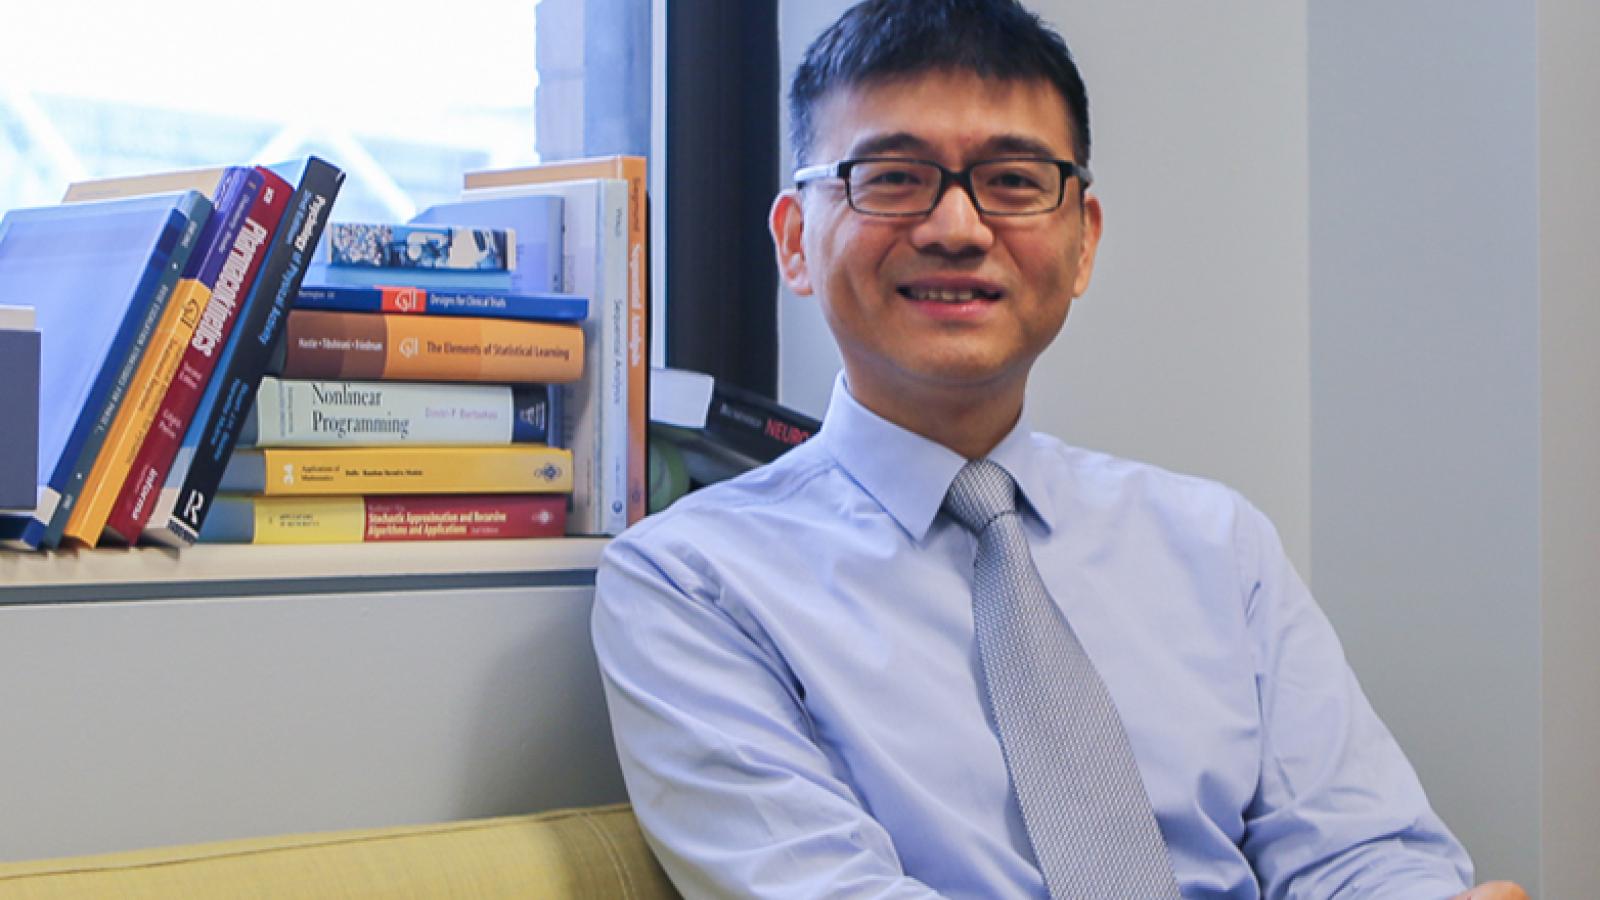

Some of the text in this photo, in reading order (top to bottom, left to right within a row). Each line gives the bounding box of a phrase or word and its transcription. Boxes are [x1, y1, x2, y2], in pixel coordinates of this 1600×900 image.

[426, 341, 570, 361] The Elements of Statistical Learning
[312, 382, 383, 406] Nonlinear
[312, 410, 410, 439] Programming
